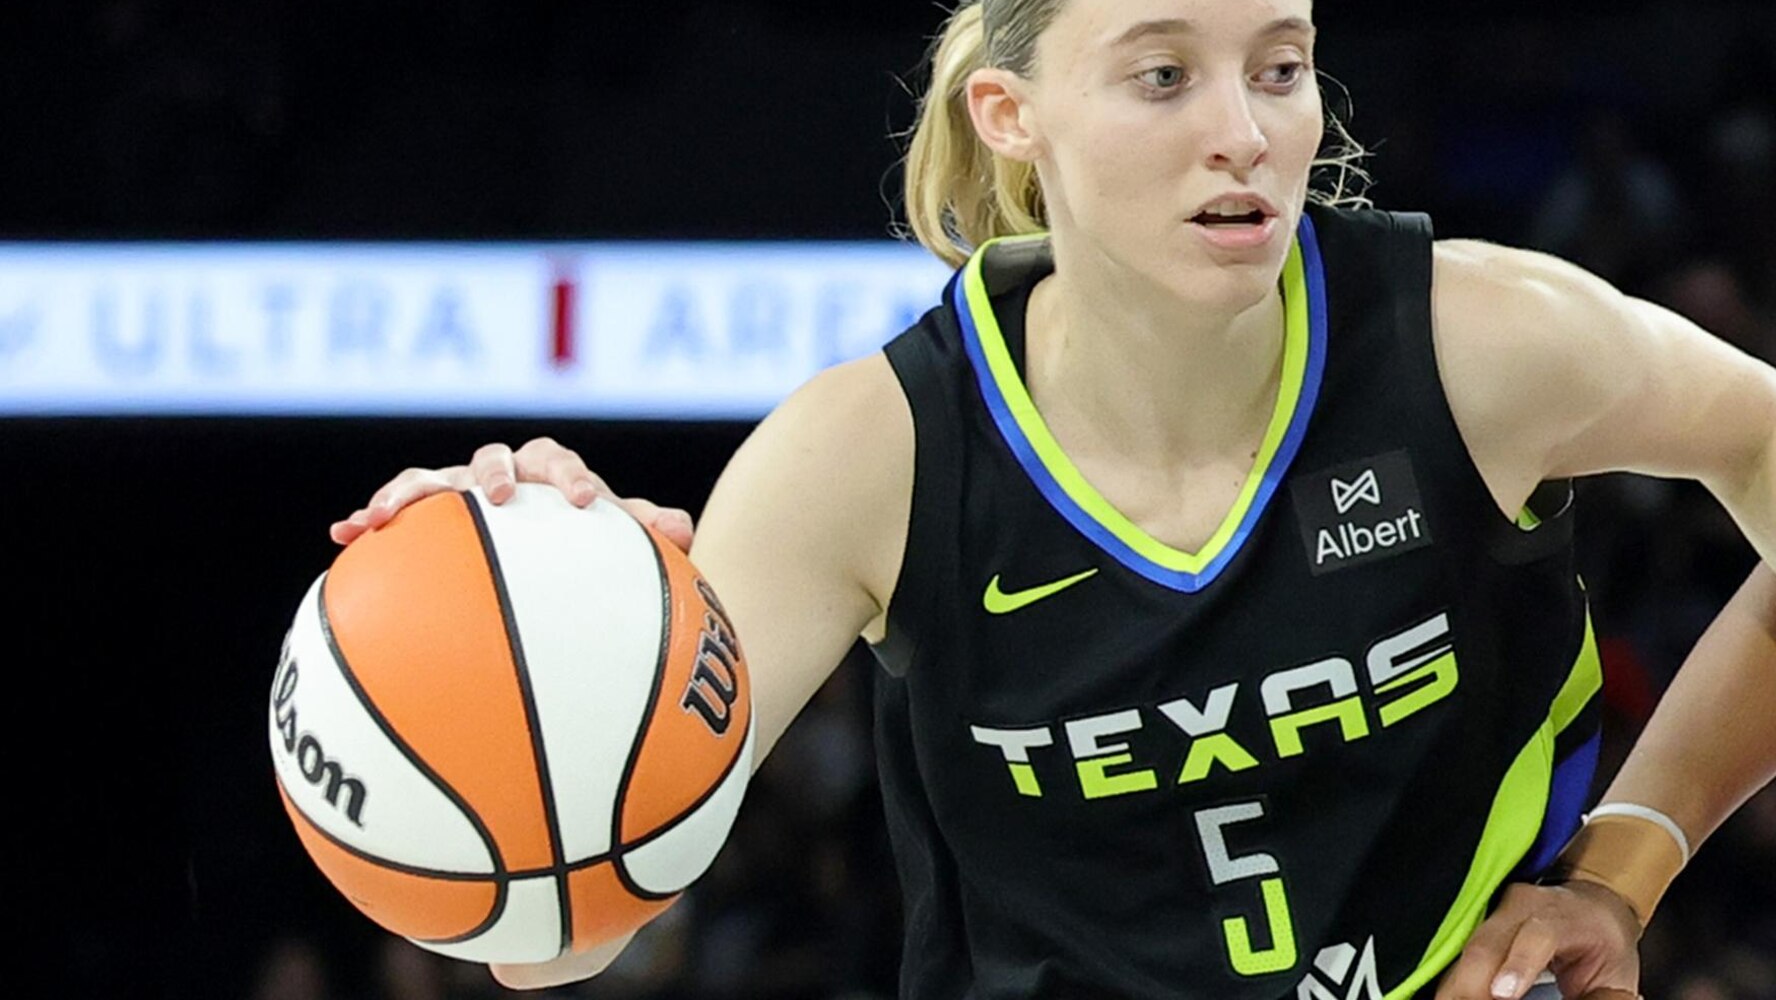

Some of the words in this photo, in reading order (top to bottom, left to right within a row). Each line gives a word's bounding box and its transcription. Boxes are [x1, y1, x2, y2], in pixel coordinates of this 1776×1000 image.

[92, 278, 480, 378] ULTRA
[1315, 507, 1422, 566] Albert
[970, 611, 1460, 800] TEXAS
[1194, 800, 1298, 976] 5
